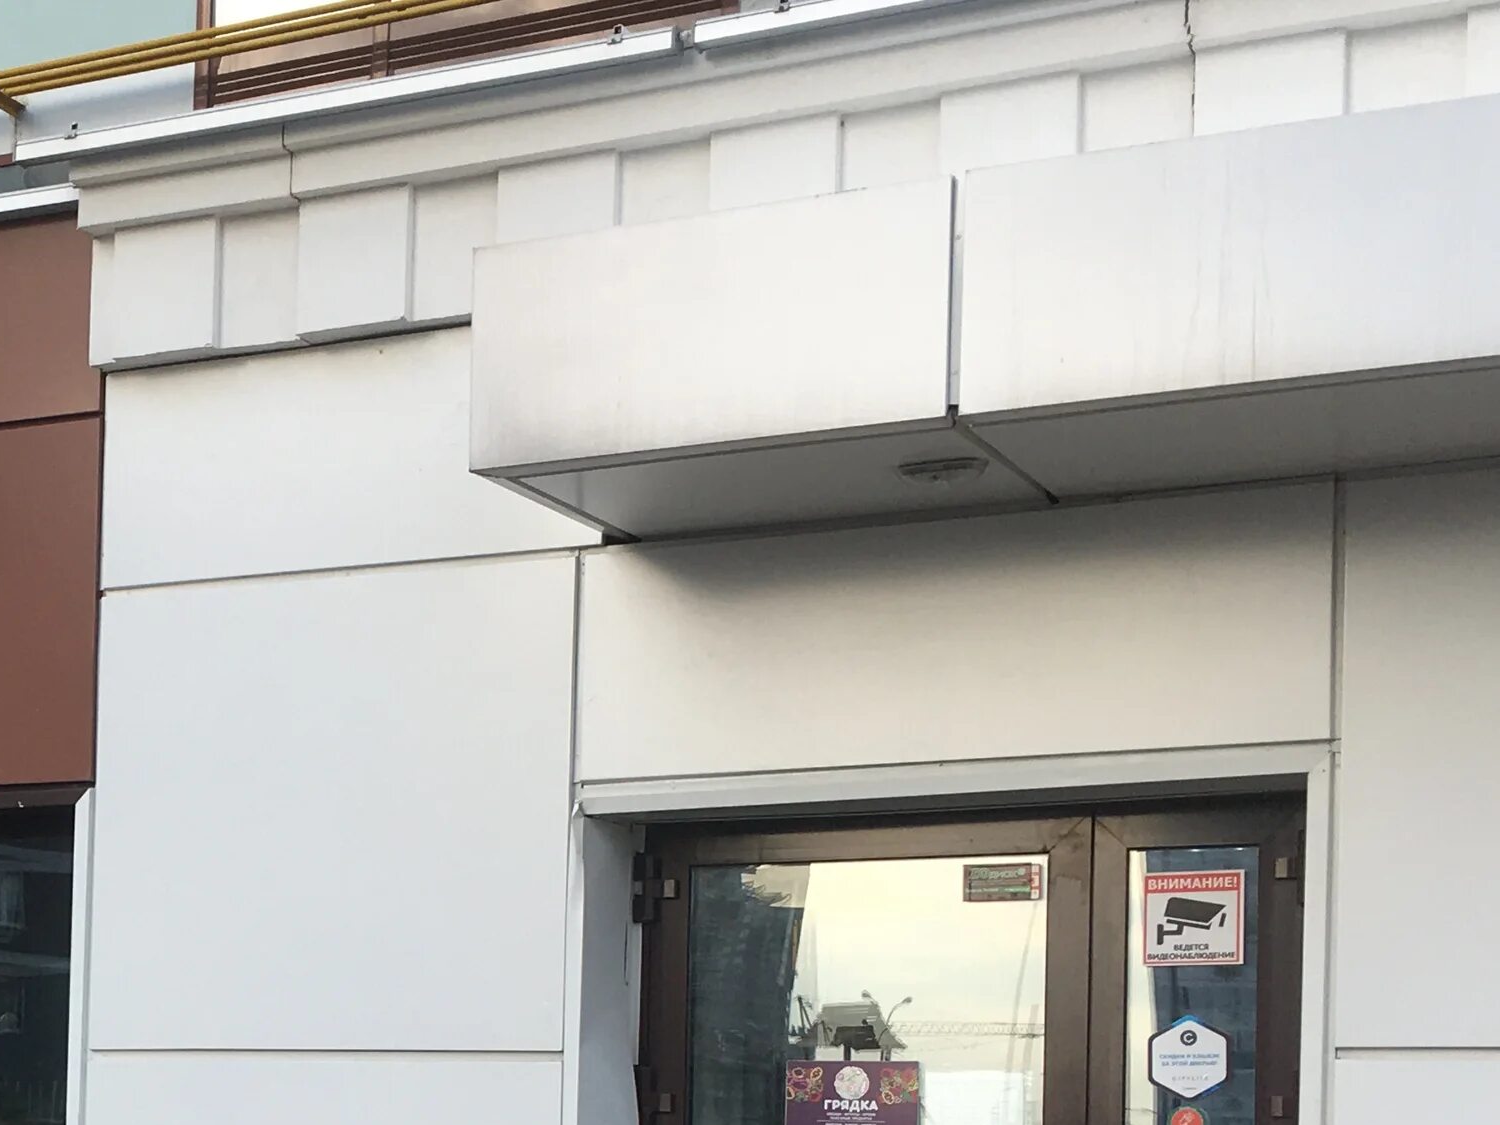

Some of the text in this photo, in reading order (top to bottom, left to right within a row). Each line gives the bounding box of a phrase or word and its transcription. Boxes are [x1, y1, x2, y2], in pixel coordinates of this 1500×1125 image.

[1147, 876, 1238, 891] ВНИМАНИЕ!
[1173, 943, 1209, 952] ВЕДЕТСЯ
[1147, 952, 1236, 961] ВИДЕОНАБЛЮДЕНИЕ
[824, 1099, 878, 1112] ГРЯДКА
